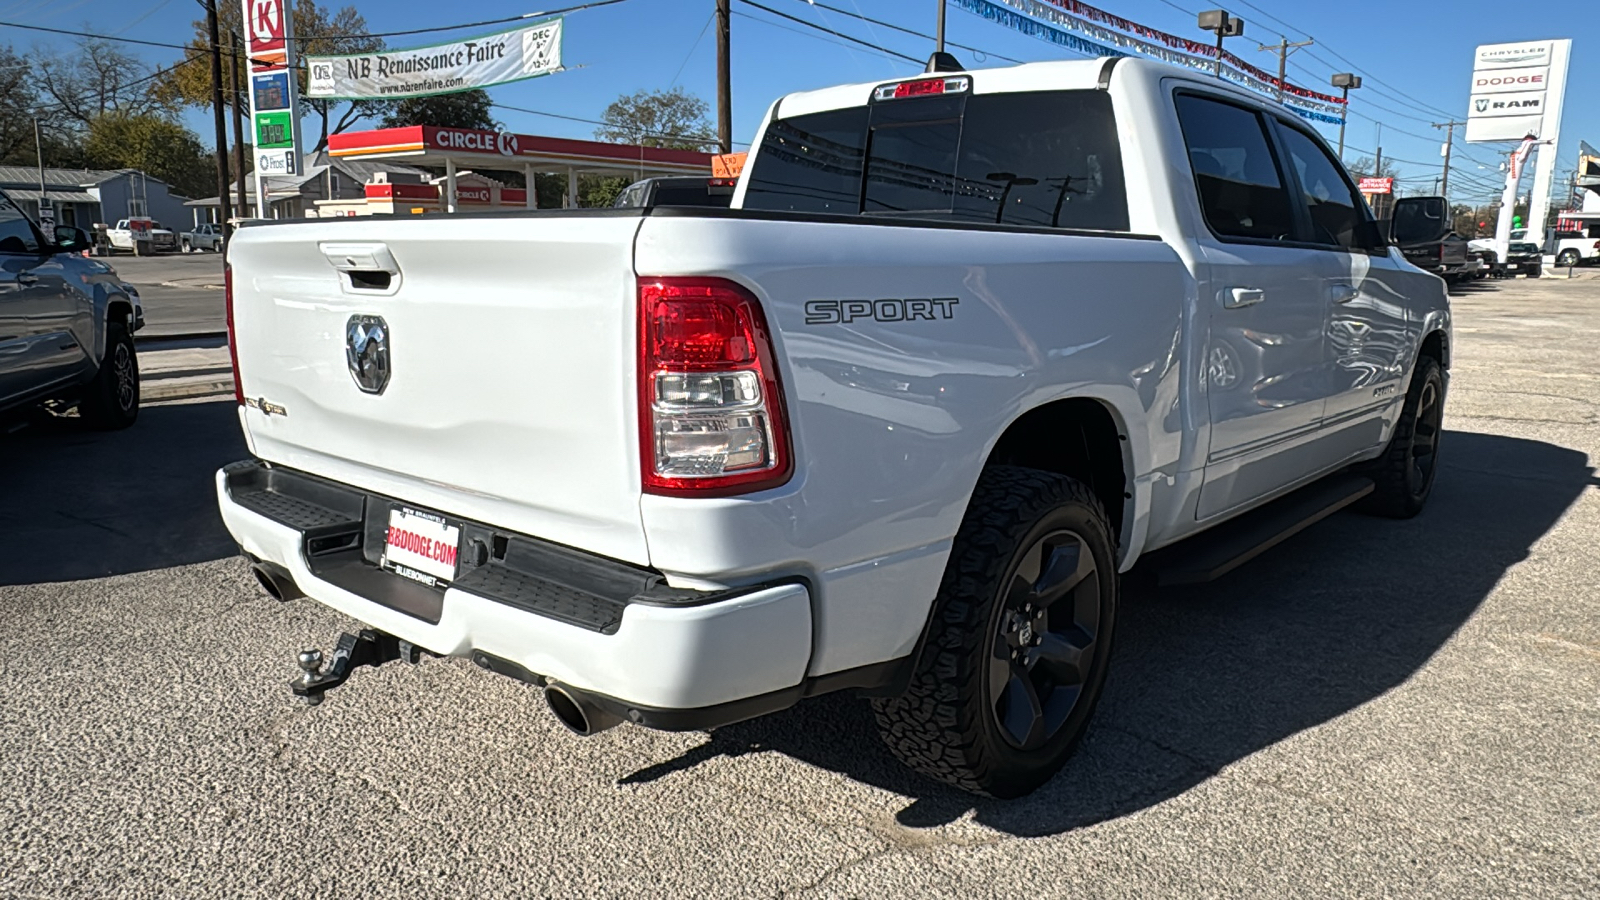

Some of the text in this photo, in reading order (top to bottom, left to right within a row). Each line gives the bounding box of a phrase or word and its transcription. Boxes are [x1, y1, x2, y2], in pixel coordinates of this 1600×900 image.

[532, 29, 550, 41] DEC
[1481, 47, 1545, 57] CHRYSLER
[346, 57, 371, 80] NB
[377, 52, 462, 79] Renaissance
[464, 41, 506, 65] Faire
[380, 76, 464, 94] www.nbrenfaire.com
[1476, 74, 1543, 86] DODGE
[1493, 99, 1540, 109] RAM
[436, 130, 517, 153] CIRCLE K
[269, 157, 285, 169] Frost
[457, 191, 480, 199] CIRCLE
[804, 297, 960, 325] SPORT
[387, 525, 457, 567] BBDODGE.COM
[395, 565, 437, 587] BLUEBONNET
